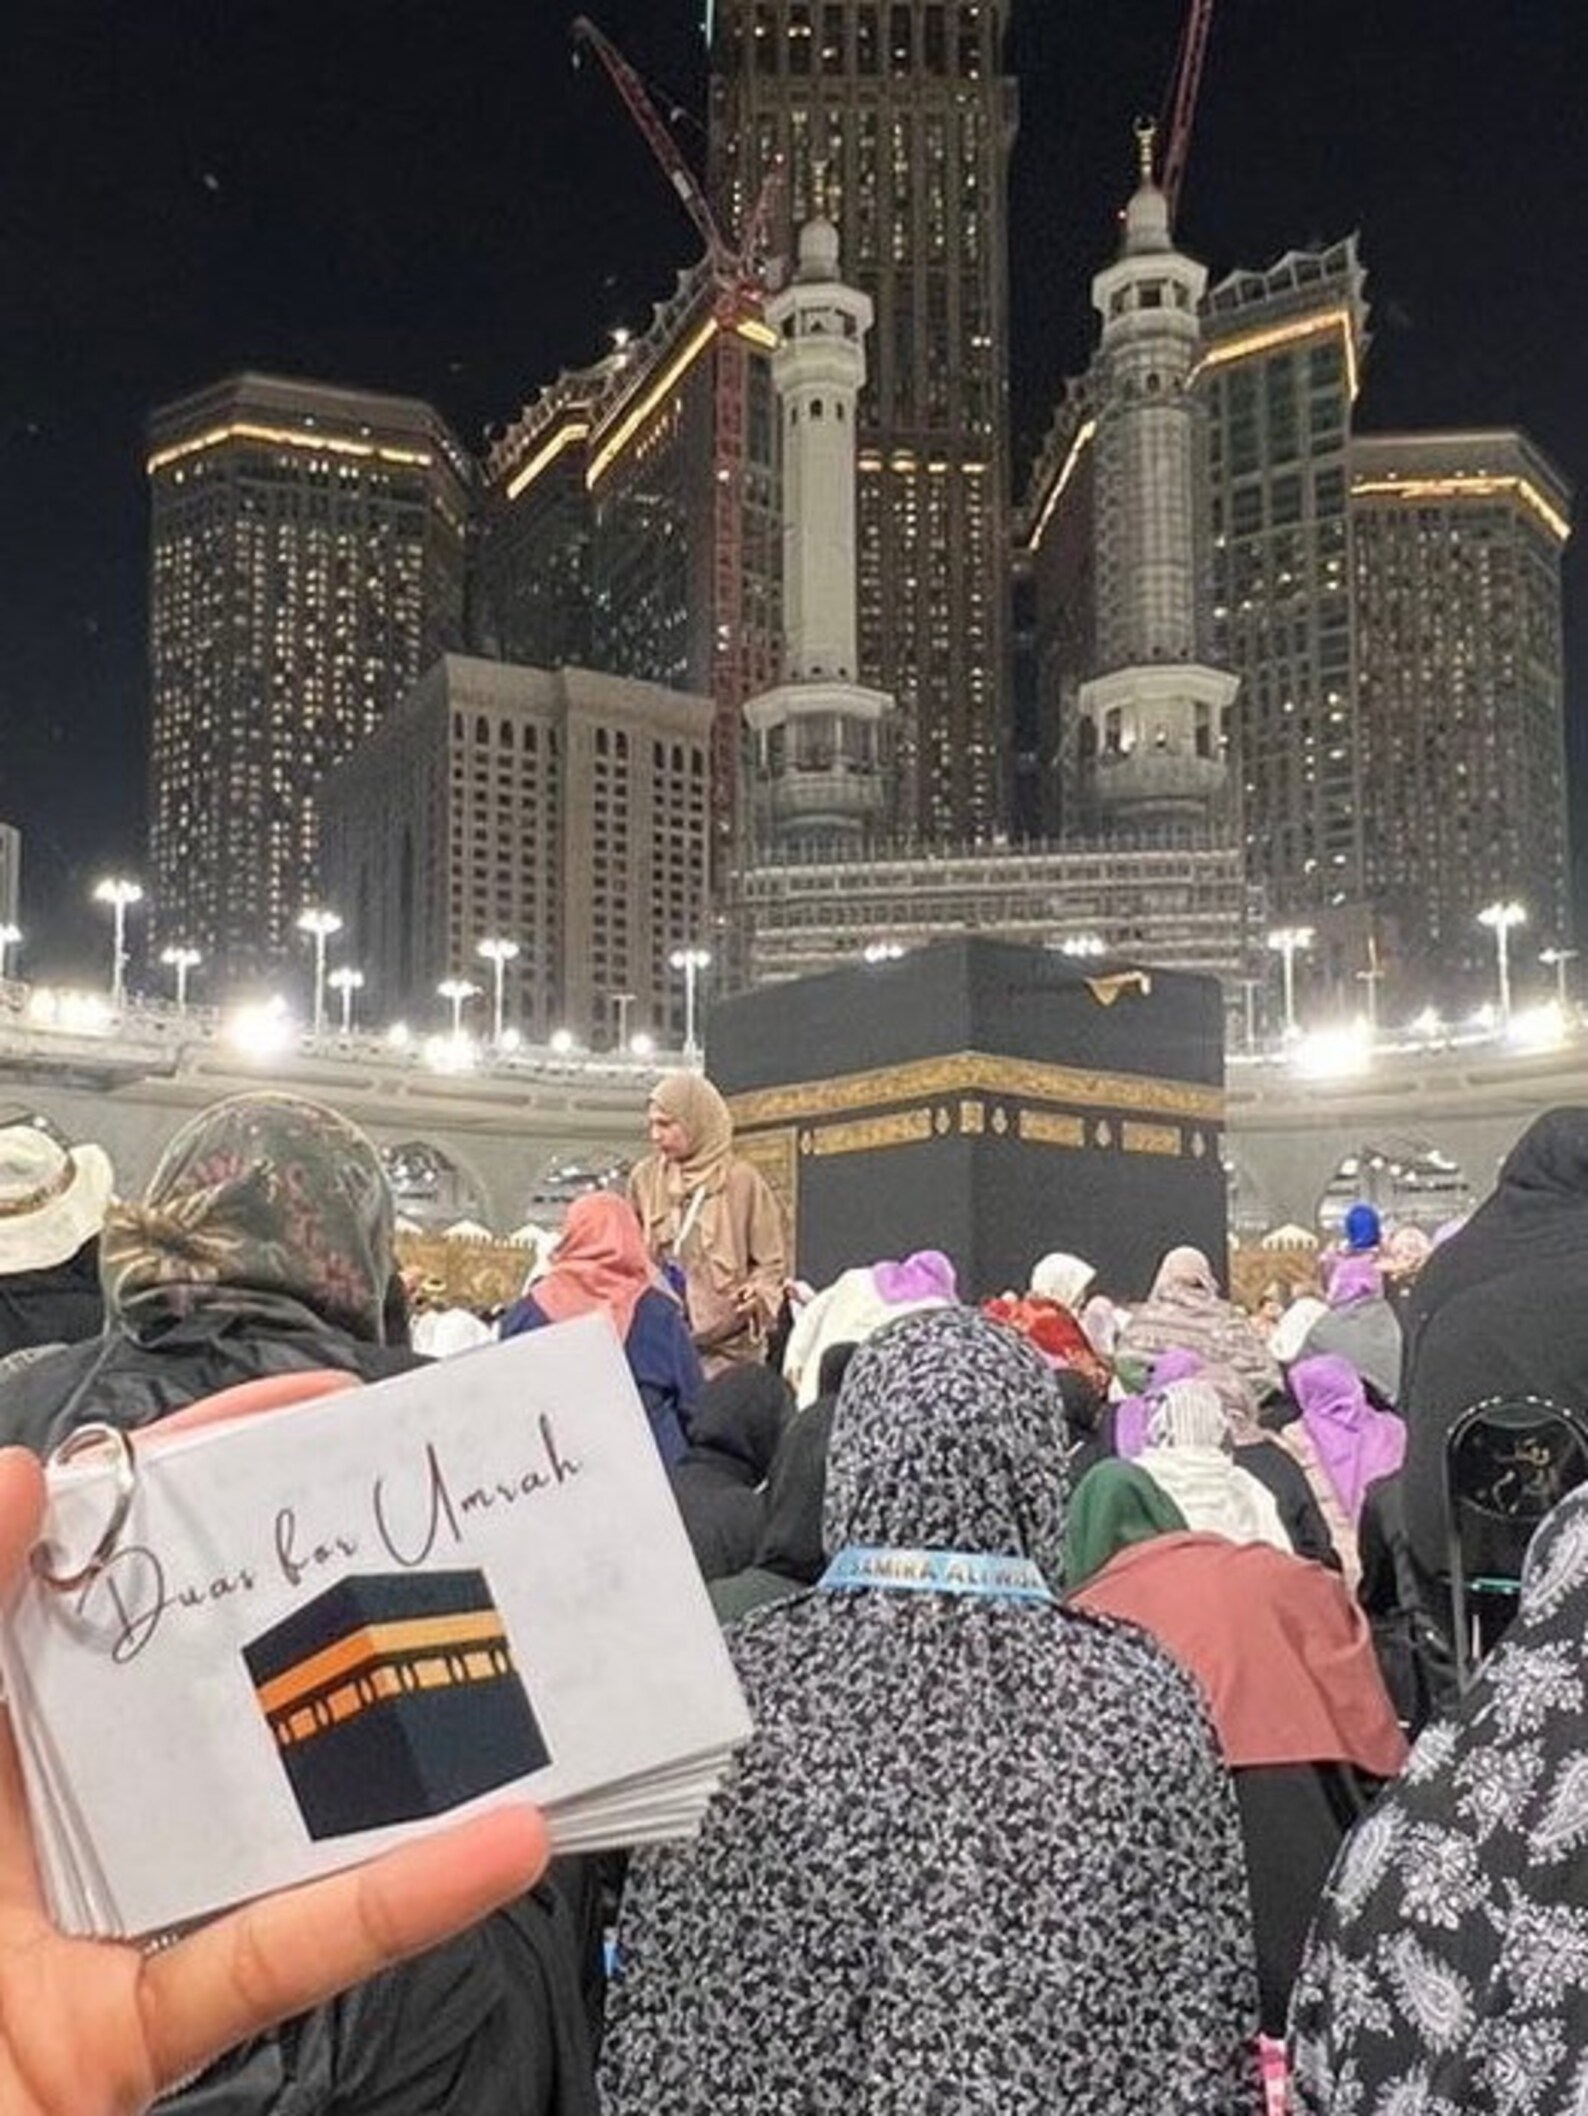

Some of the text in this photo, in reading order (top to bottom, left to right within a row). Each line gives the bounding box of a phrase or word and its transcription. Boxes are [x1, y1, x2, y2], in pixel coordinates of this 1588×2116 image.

[76, 1412, 582, 1664] Duas for Umrah
